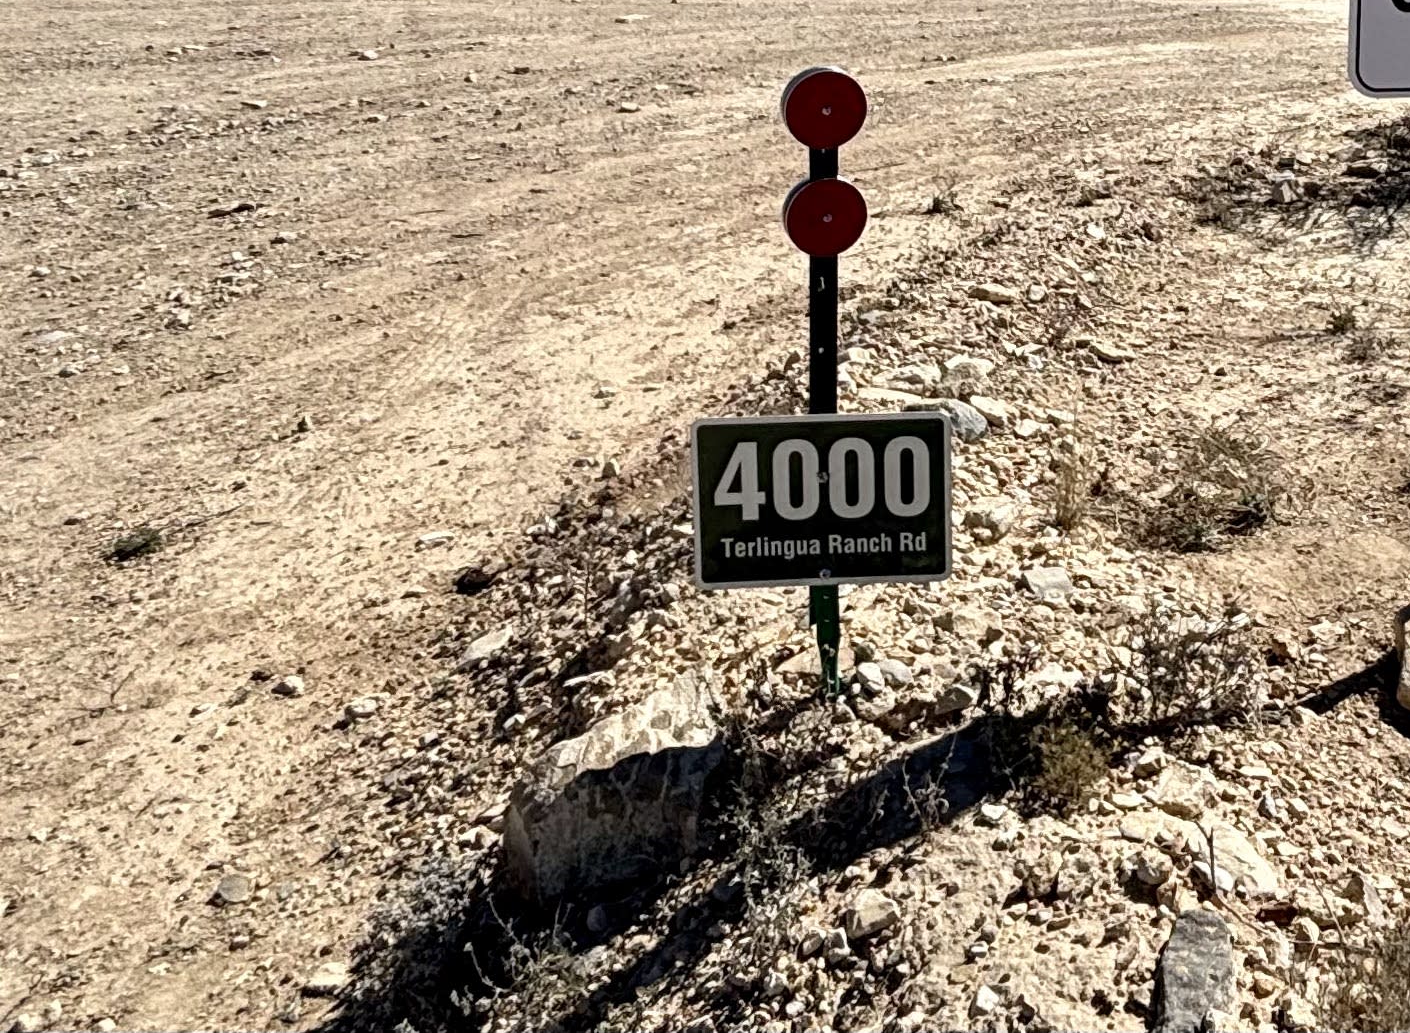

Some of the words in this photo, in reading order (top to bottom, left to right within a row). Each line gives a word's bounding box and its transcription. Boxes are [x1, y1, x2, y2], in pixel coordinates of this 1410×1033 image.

[714, 436, 930, 521] 4000
[721, 537, 820, 559] Terlingua
[828, 533, 892, 554] Ranch
[900, 531, 926, 551] Rd
